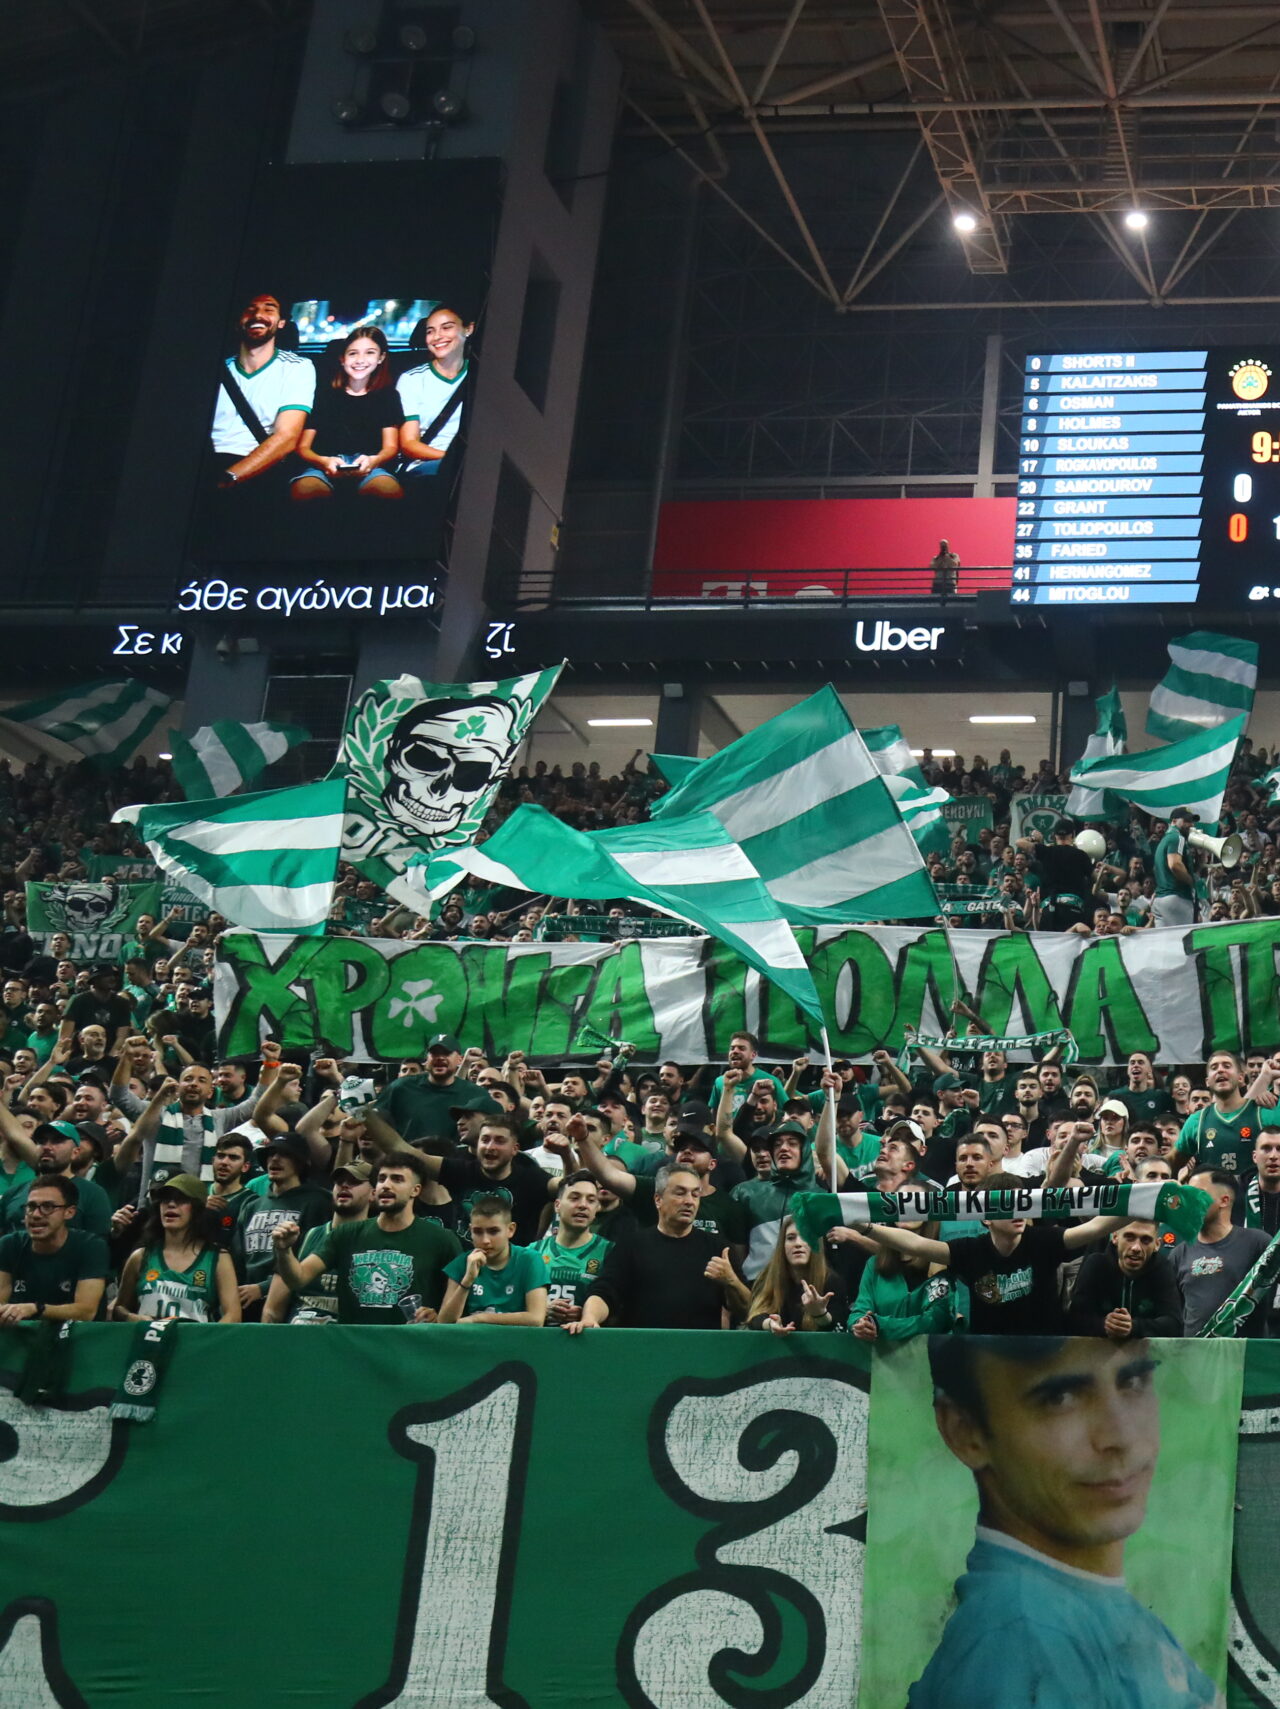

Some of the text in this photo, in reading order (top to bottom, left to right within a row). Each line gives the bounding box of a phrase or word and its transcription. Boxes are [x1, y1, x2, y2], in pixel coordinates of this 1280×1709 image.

[1031, 355, 1135, 370] 0 SHORTS II
[1030, 374, 1158, 390] 5 KALAITZAKIS
[1028, 396, 1115, 411] 6 OSMAN
[1027, 416, 1122, 431] 8 HOLMES
[1024, 437, 1129, 452] 10 SLOUKAS
[1022, 460, 1038, 473] 17
[1020, 478, 1153, 494] 20 SAMODUROV
[1233, 473, 1252, 503] 0
[1018, 500, 1108, 515] 22 GRANT
[1017, 520, 1154, 537] 27 TOLIOPOULOS
[1229, 513, 1248, 543] 0
[1016, 543, 1107, 558] 35 FARIED
[1014, 567, 1030, 580] 41
[256, 579, 373, 617] αγώνα
[380, 584, 437, 616] μα
[1013, 586, 1130, 602] 44 MITOGLOU
[113, 625, 183, 656] Σε κ
[855, 621, 945, 652] Uber
[1221, 1152, 1237, 1171] 25
[1041, 1185, 1121, 1210] RAPID
[14, 1279, 27, 1293] 25
[548, 1284, 577, 1307] 25
